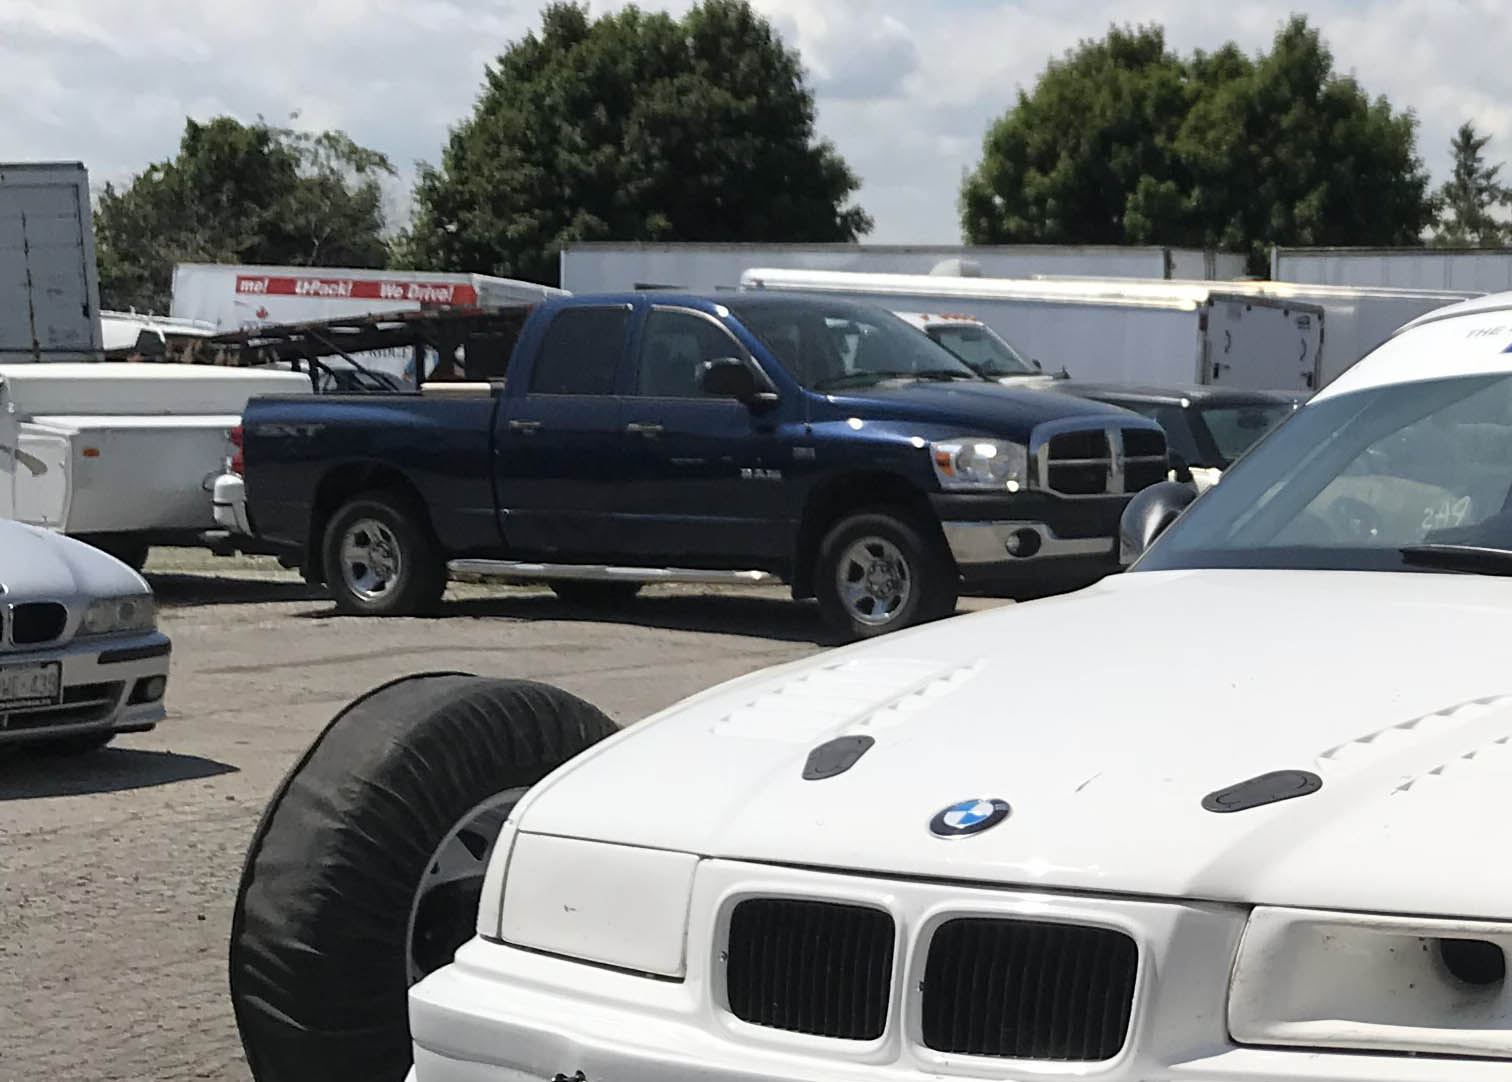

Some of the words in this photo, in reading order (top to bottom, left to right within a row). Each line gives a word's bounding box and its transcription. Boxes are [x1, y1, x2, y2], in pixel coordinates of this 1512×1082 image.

[379, 282, 403, 299] We
[407, 284, 454, 301] Drive!
[1466, 326, 1505, 339] THE
